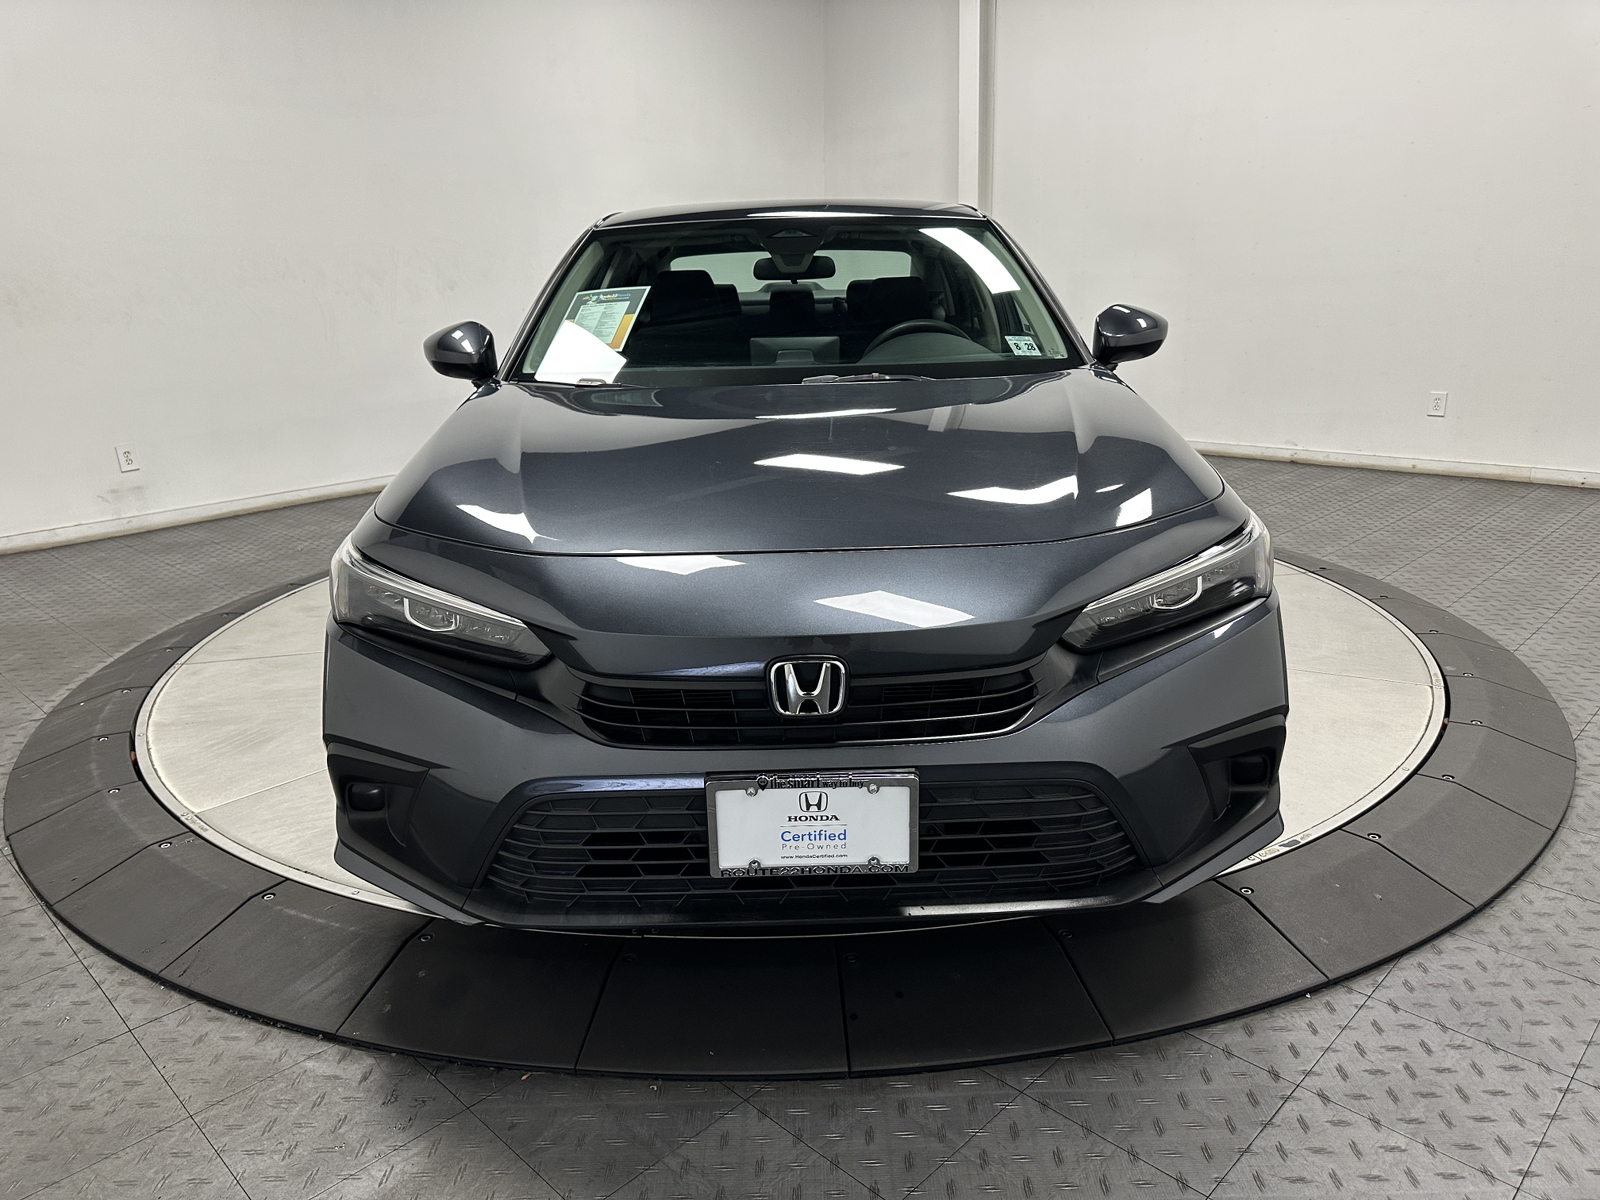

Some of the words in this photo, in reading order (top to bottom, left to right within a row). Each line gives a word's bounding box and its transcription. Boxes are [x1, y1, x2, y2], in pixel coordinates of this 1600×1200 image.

[1014, 342, 1021, 350] 8
[1025, 343, 1036, 351] 28
[771, 776, 785, 788] the
[787, 775, 819, 788] smart
[822, 779, 838, 789] way
[839, 778, 848, 788] to
[849, 775, 864, 788] buy
[780, 829, 847, 842] Certified
[781, 843, 847, 851] Pre-Owned
[720, 864, 909, 878] ROUTE22HONDA.COM
